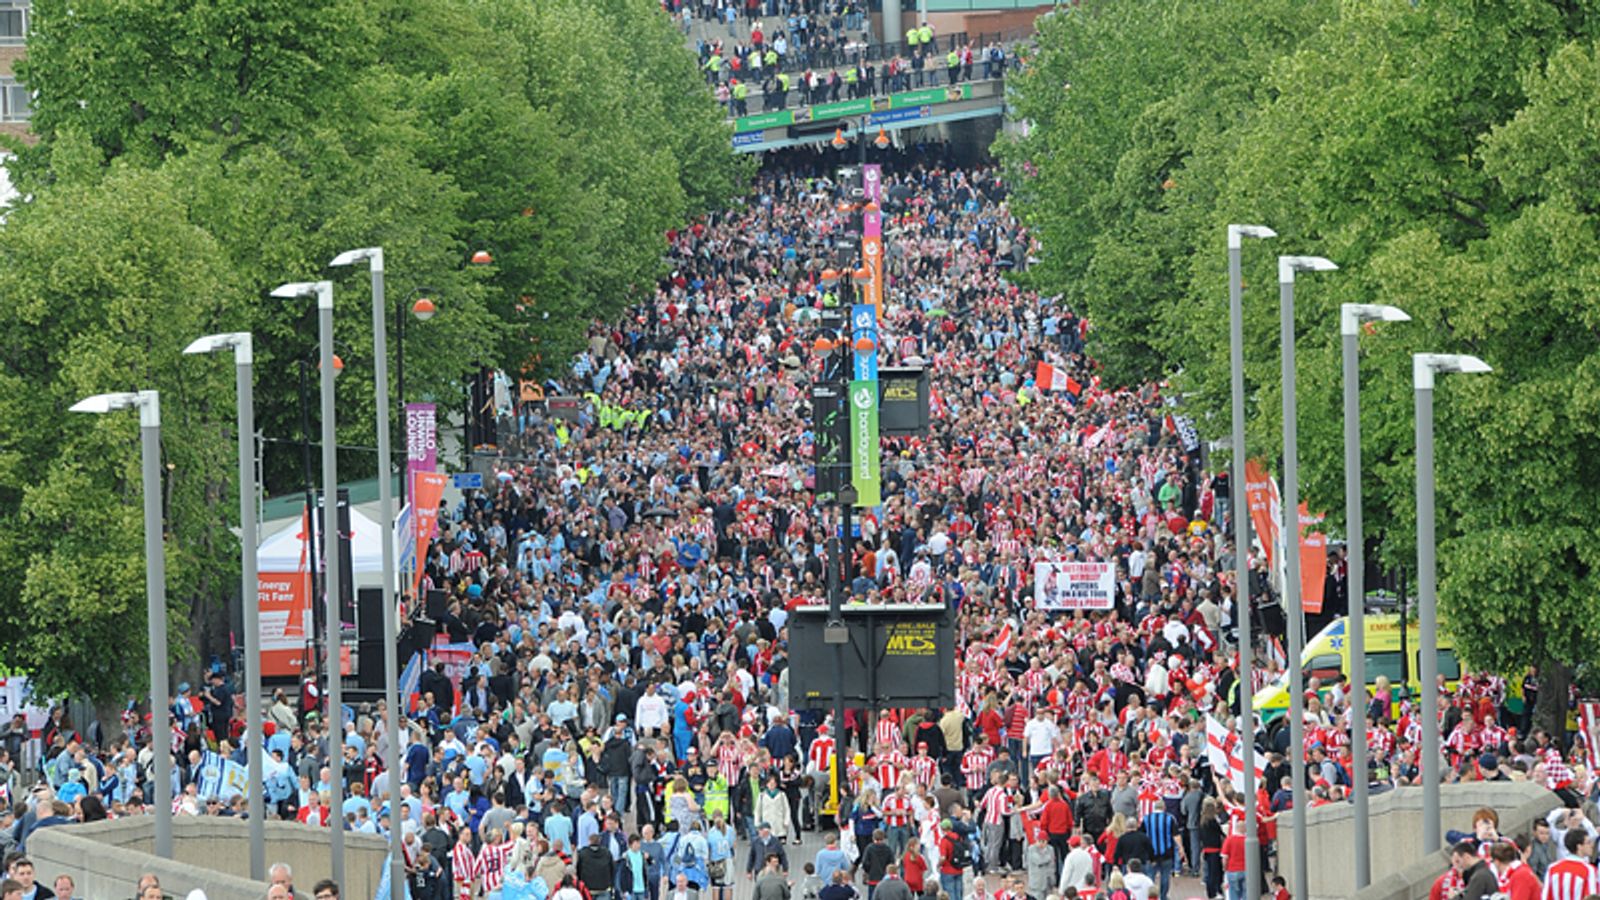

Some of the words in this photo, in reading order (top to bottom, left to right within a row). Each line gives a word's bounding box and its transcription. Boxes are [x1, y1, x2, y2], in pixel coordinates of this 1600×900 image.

[408, 411, 417, 460] LOUNGE
[418, 410, 427, 461] UNWIND
[427, 410, 435, 449] HELLO
[858, 411, 871, 480] barclaycard
[258, 580, 291, 591] Energy
[258, 592, 270, 601] Fit
